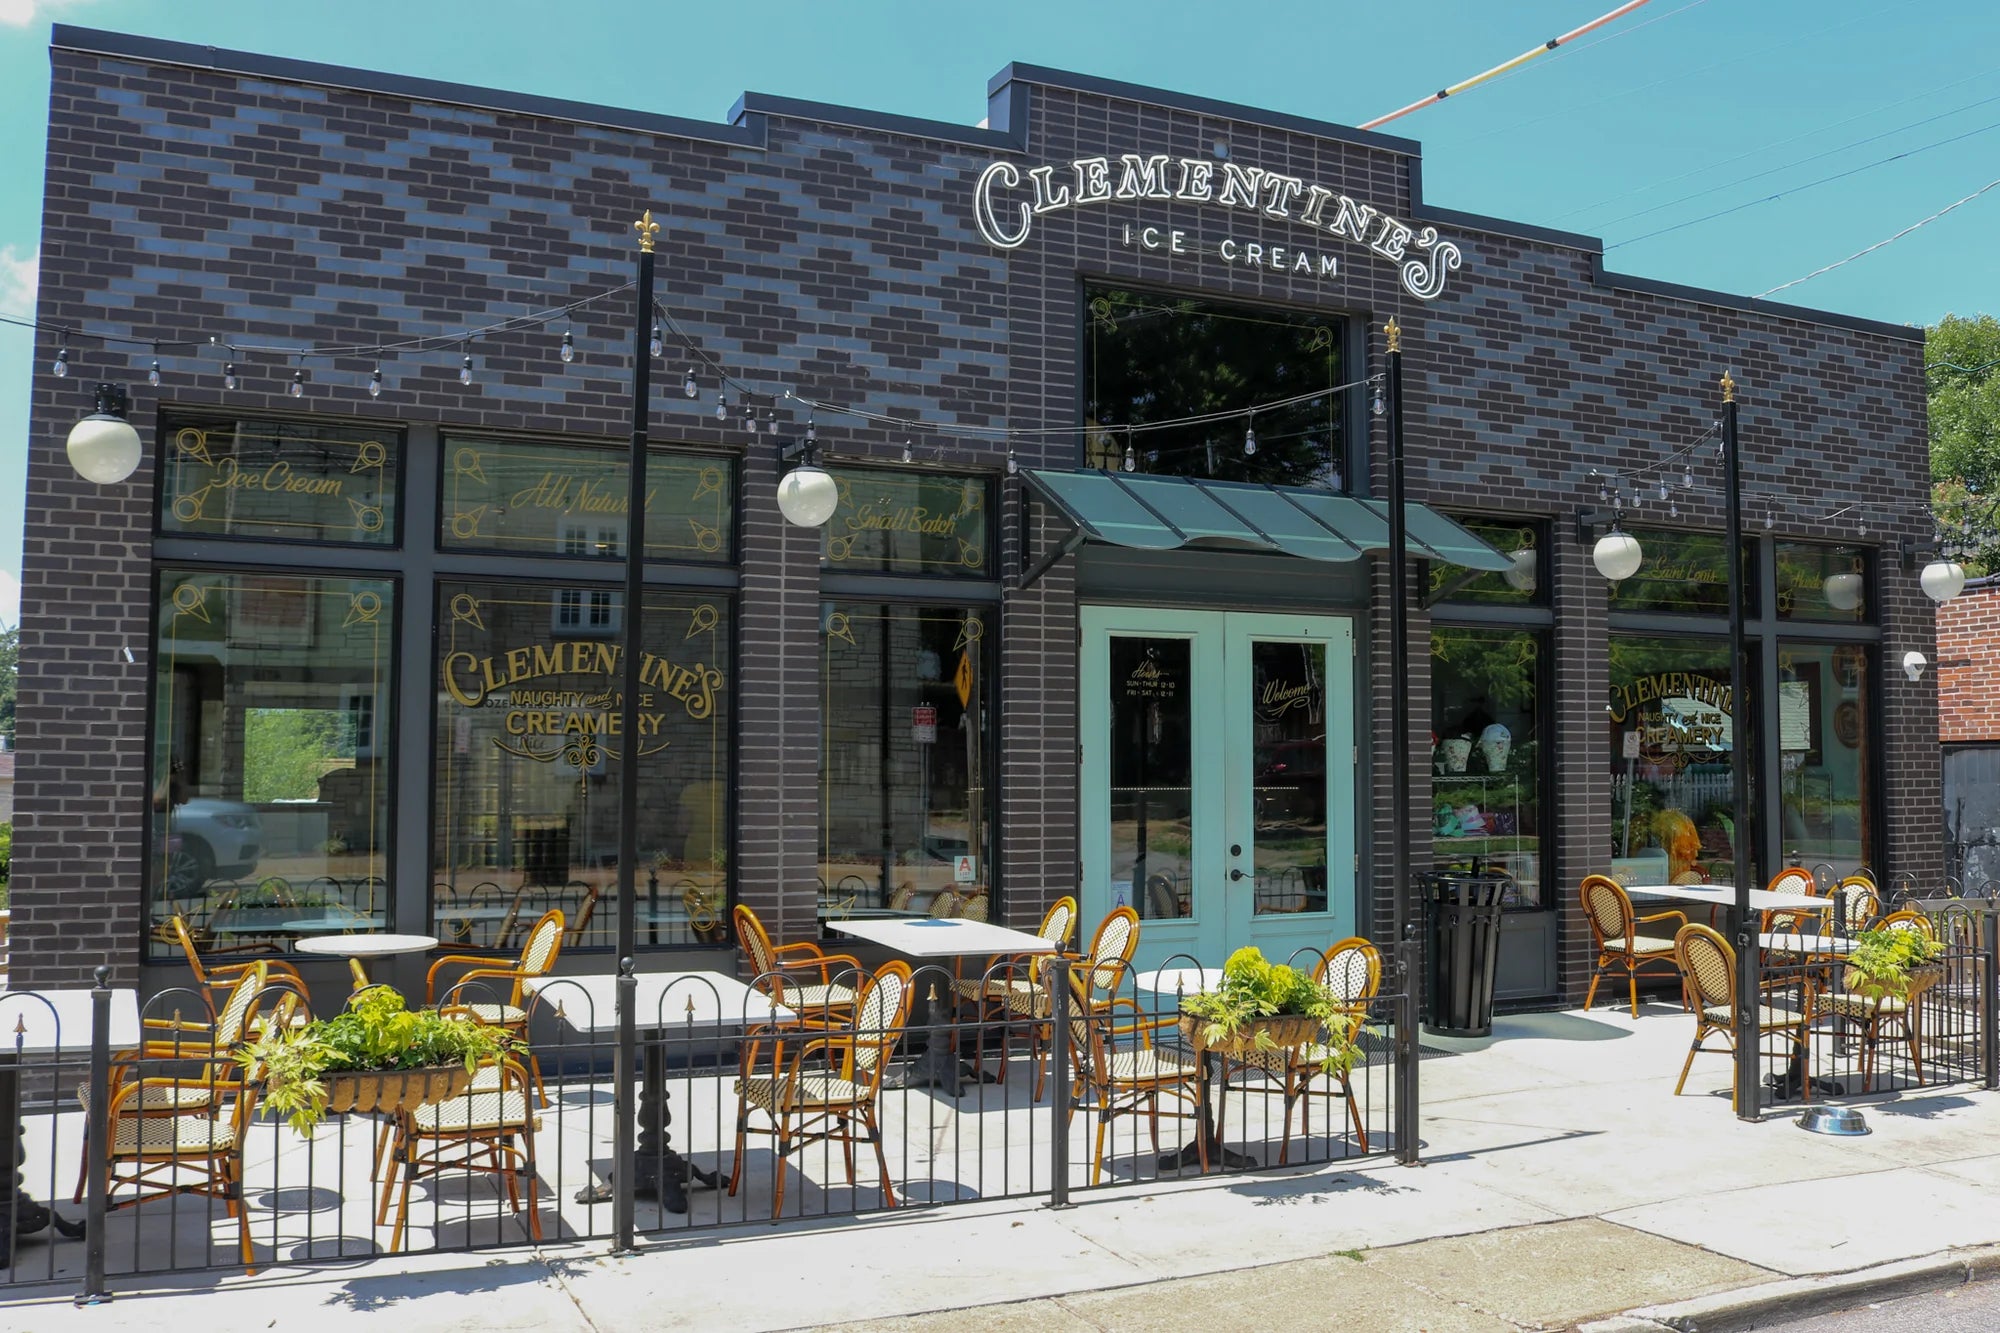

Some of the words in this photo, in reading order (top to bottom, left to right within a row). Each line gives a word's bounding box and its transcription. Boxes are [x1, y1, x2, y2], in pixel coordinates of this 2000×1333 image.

[974, 154, 1463, 300] CLEMENTINE'S
[1122, 223, 1186, 254] ICE
[1220, 239, 1338, 278] CREAM
[210, 458, 260, 488] Ice
[262, 461, 343, 497] Cream
[511, 472, 573, 510] All
[564, 478, 656, 516] Naturl
[845, 505, 908, 531] Small
[907, 507, 956, 534] Batch
[443, 641, 724, 720] CLEMENINE'S
[1131, 660, 1167, 678] Hours
[510, 690, 584, 707] NAUGHTY
[585, 687, 613, 709] and
[1263, 679, 1312, 704] Welcome
[1638, 712, 1679, 725] NAUGHTY
[1701, 712, 1722, 725] NICE
[1635, 726, 1724, 746] CREAMERY
[959, 857, 971, 872] A
[1115, 893, 1126, 909] A
